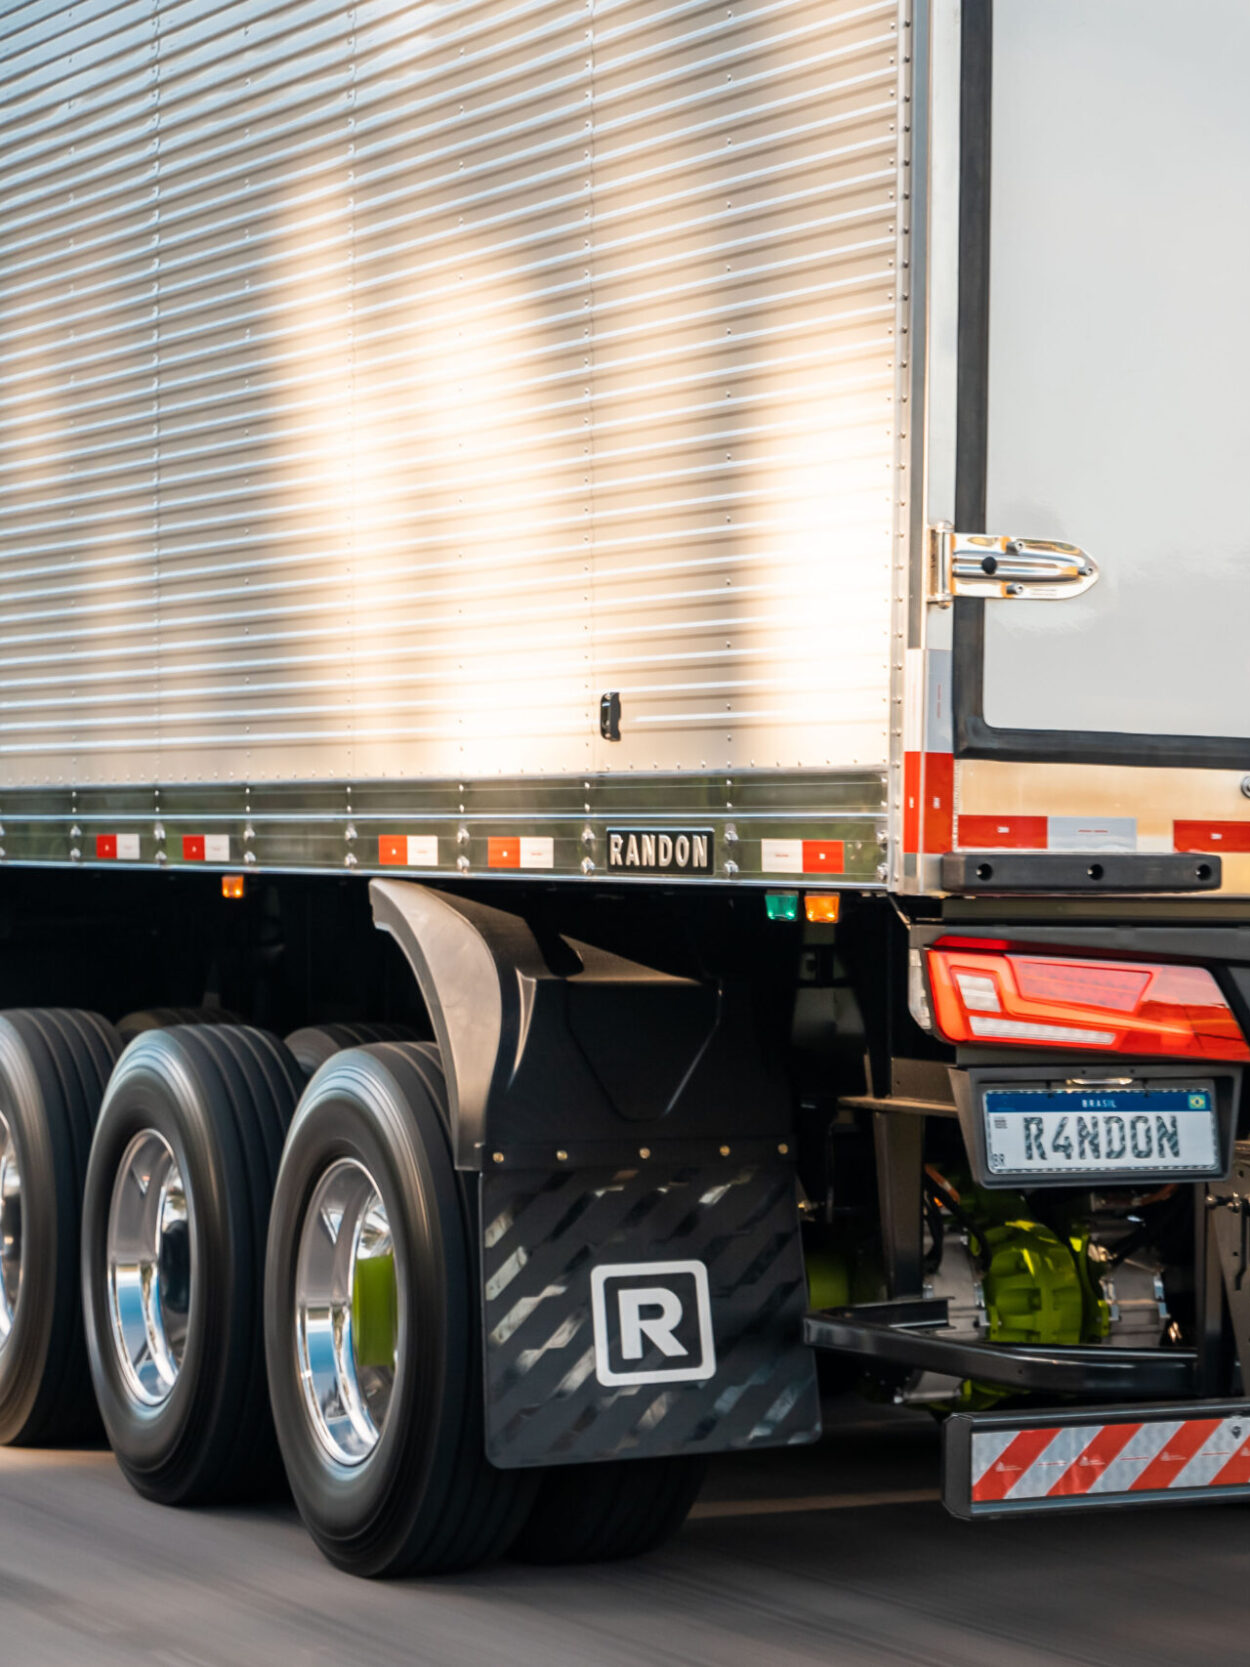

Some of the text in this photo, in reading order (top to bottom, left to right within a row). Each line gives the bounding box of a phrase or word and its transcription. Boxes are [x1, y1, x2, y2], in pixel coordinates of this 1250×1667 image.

[610, 834, 708, 867] RANDON
[1082, 1099, 1117, 1108] BRASIL
[1023, 1115, 1180, 1160] R4NDON
[617, 1287, 689, 1360] R
